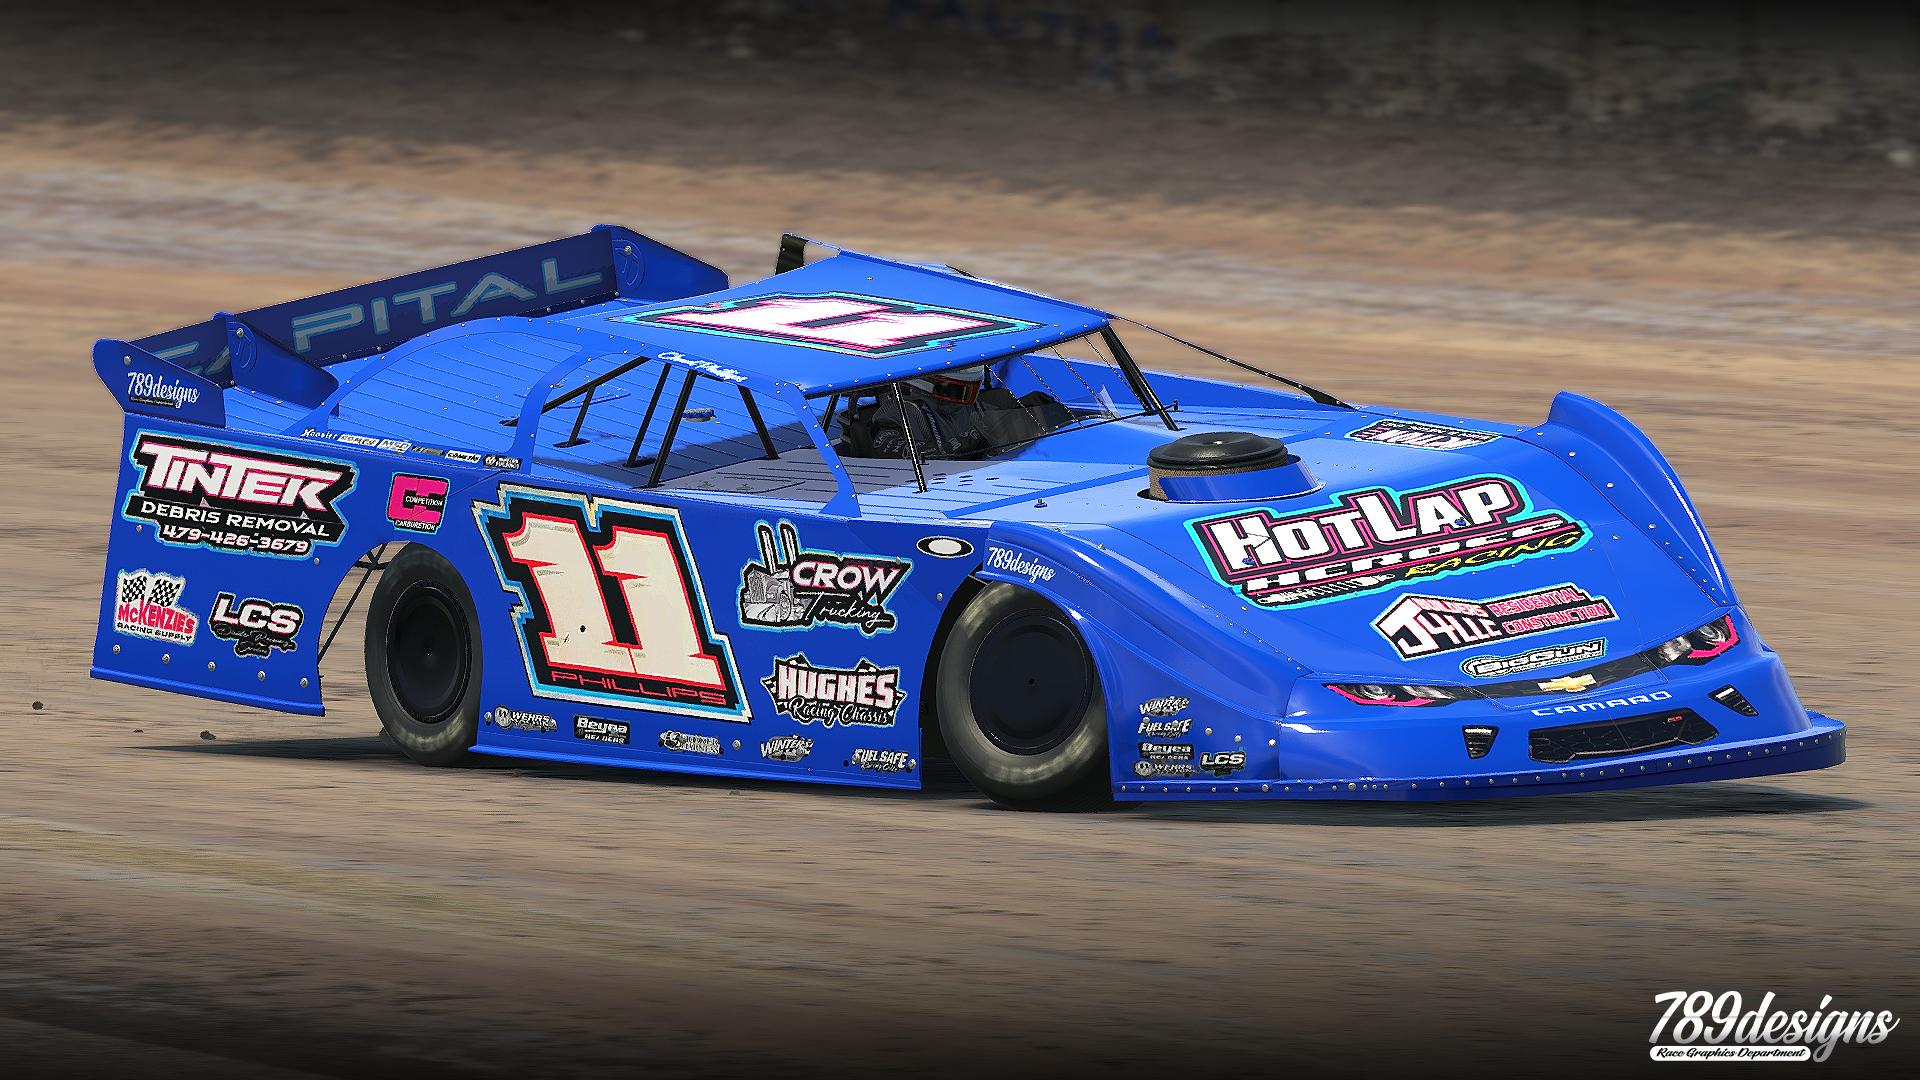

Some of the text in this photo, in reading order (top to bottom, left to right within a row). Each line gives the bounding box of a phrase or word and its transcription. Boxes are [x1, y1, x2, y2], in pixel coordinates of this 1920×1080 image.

[149, 256, 603, 376] PITAL
[127, 371, 201, 409] 789designs
[405, 495, 443, 507] COMPETITION
[140, 501, 330, 537] DEBRIS REMOVAL
[162, 524, 309, 553] 479-426-3679
[1404, 530, 1581, 578] RACING
[791, 560, 902, 594] CROW
[986, 546, 1057, 583] 789designs
[212, 597, 301, 635] LCS
[503, 511, 727, 691] 11
[798, 592, 891, 627] Trucking
[1486, 588, 1586, 618] RESIDENTIAL
[116, 622, 153, 634] RACING
[1501, 603, 1611, 635] CONSTRUCTION
[551, 669, 727, 706] PHILLIPS
[775, 664, 896, 709] HUGHES
[1530, 689, 1673, 716] CAMARO
[879, 750, 909, 769] SAFE
[1201, 753, 1245, 766] LCS
